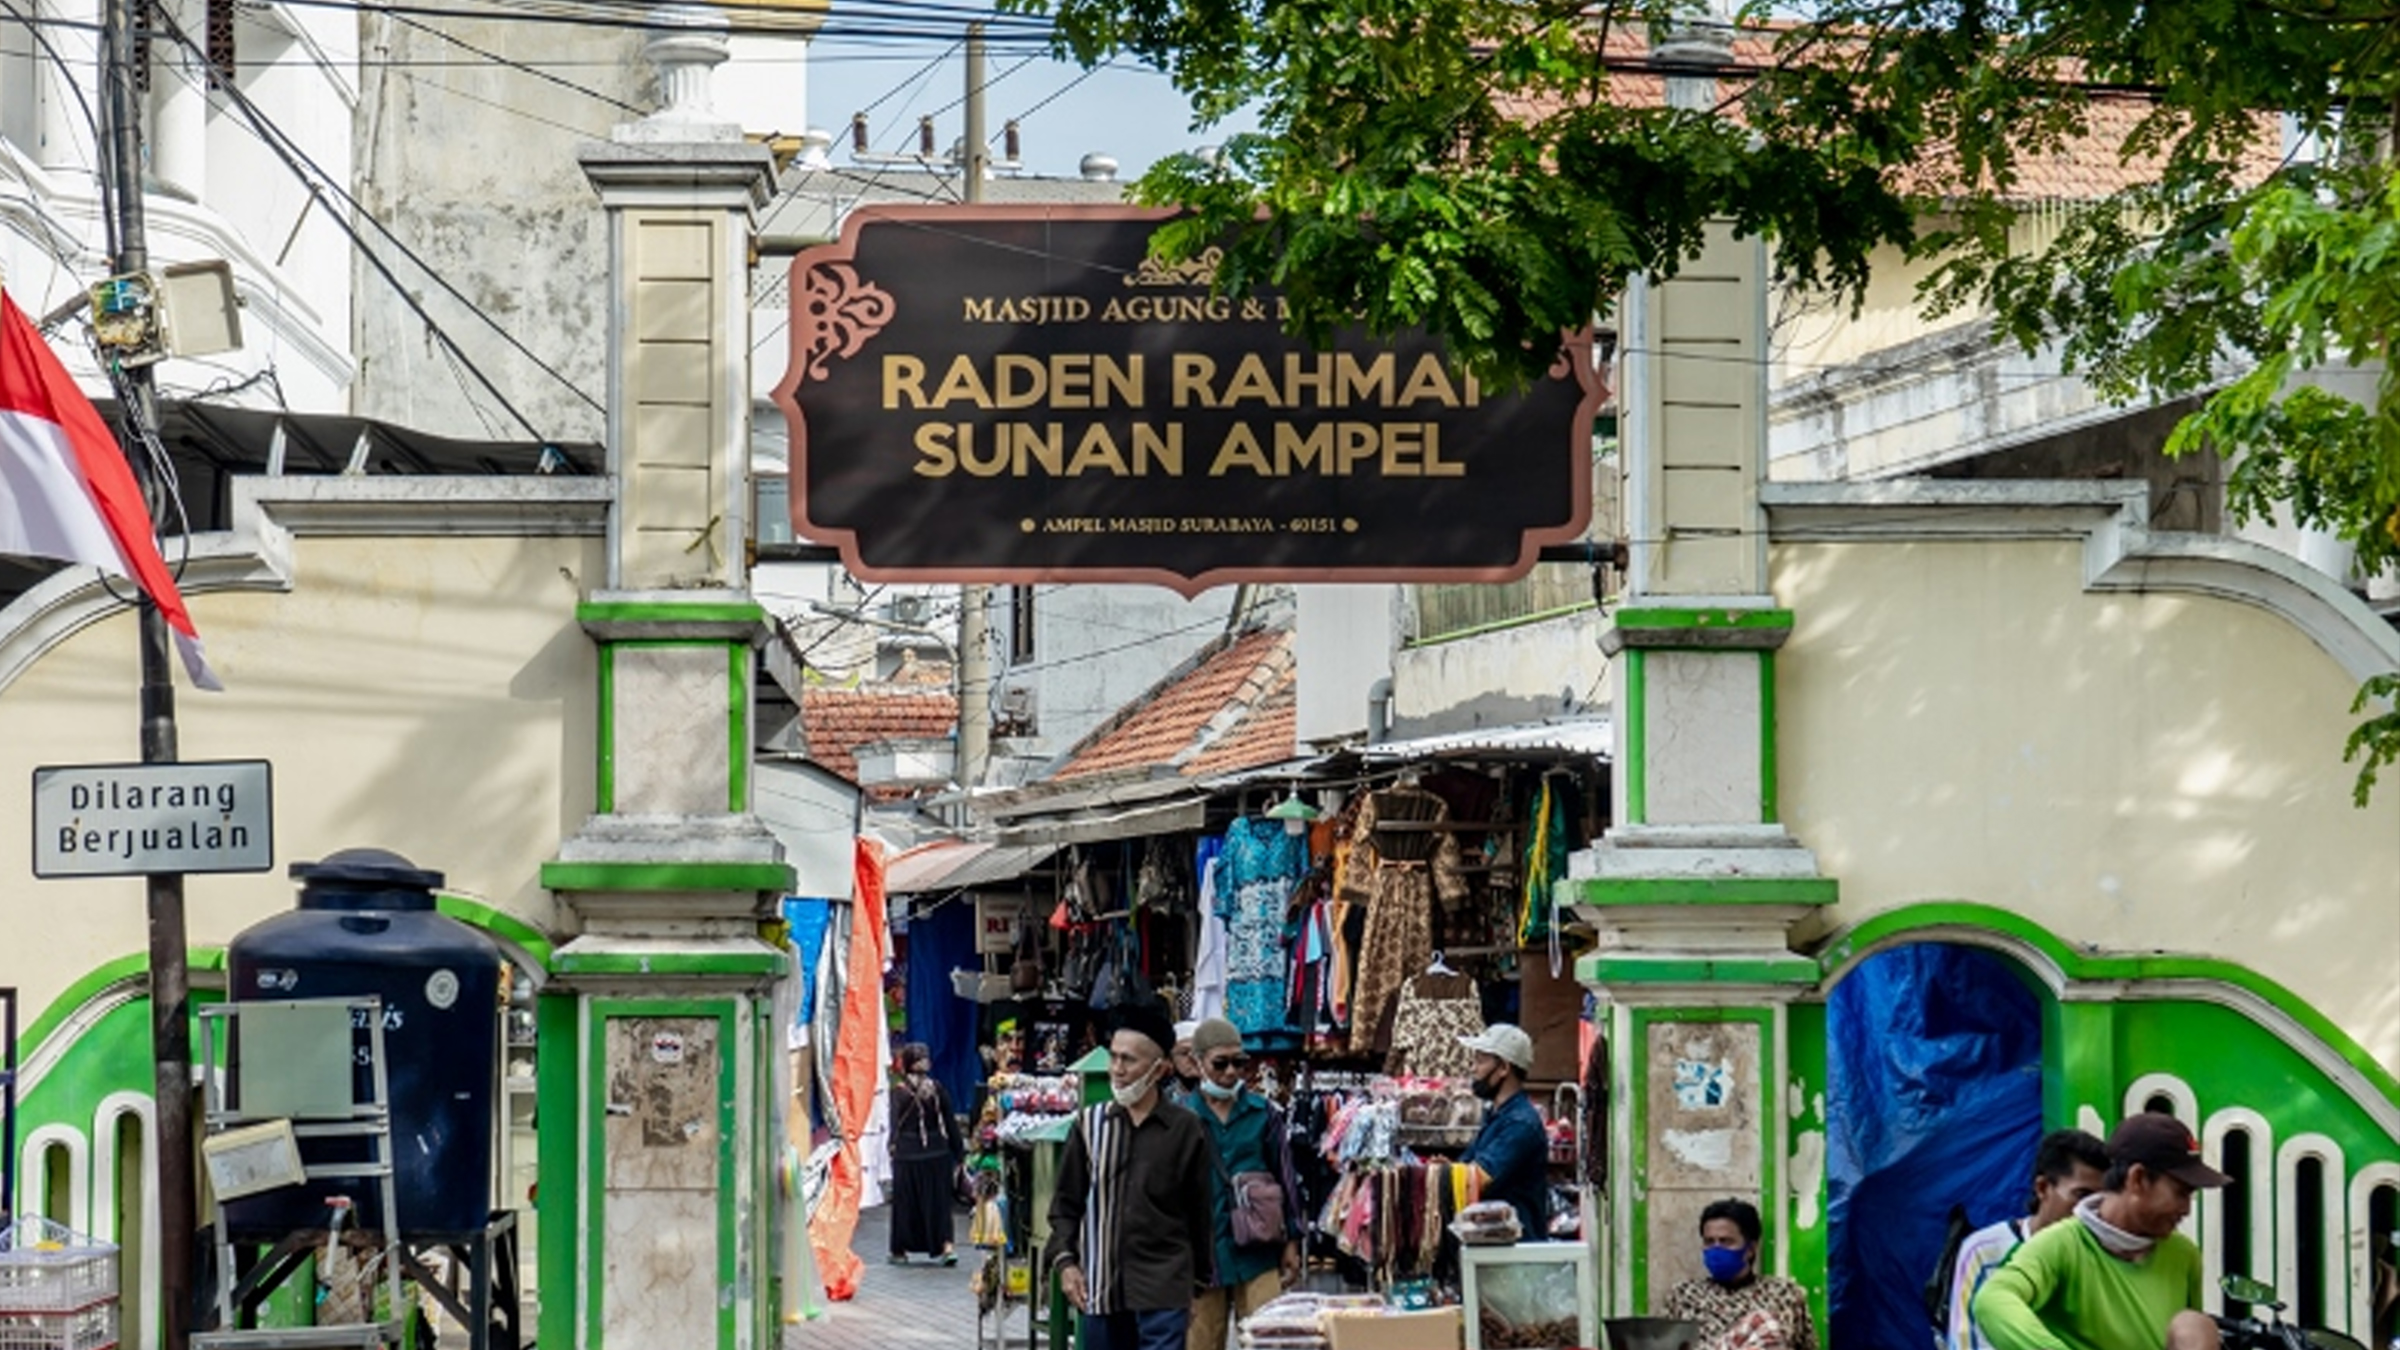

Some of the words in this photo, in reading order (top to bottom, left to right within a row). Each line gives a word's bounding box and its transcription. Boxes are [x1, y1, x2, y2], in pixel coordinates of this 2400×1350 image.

[963, 297, 1091, 325] MASJID
[1101, 297, 1231, 321] AGUNG
[1240, 297, 1267, 321] &
[882, 354, 1144, 409] RADEN
[913, 422, 1184, 477] SUNAN
[1208, 422, 1466, 477] AMPEL
[1043, 518, 1106, 532] AMPEL
[1109, 518, 1175, 534] MASJID
[1180, 518, 1274, 532] SURABAYA
[1290, 518, 1336, 532] 60151
[71, 781, 235, 813] Dilarang
[59, 821, 248, 859] Berjualan
